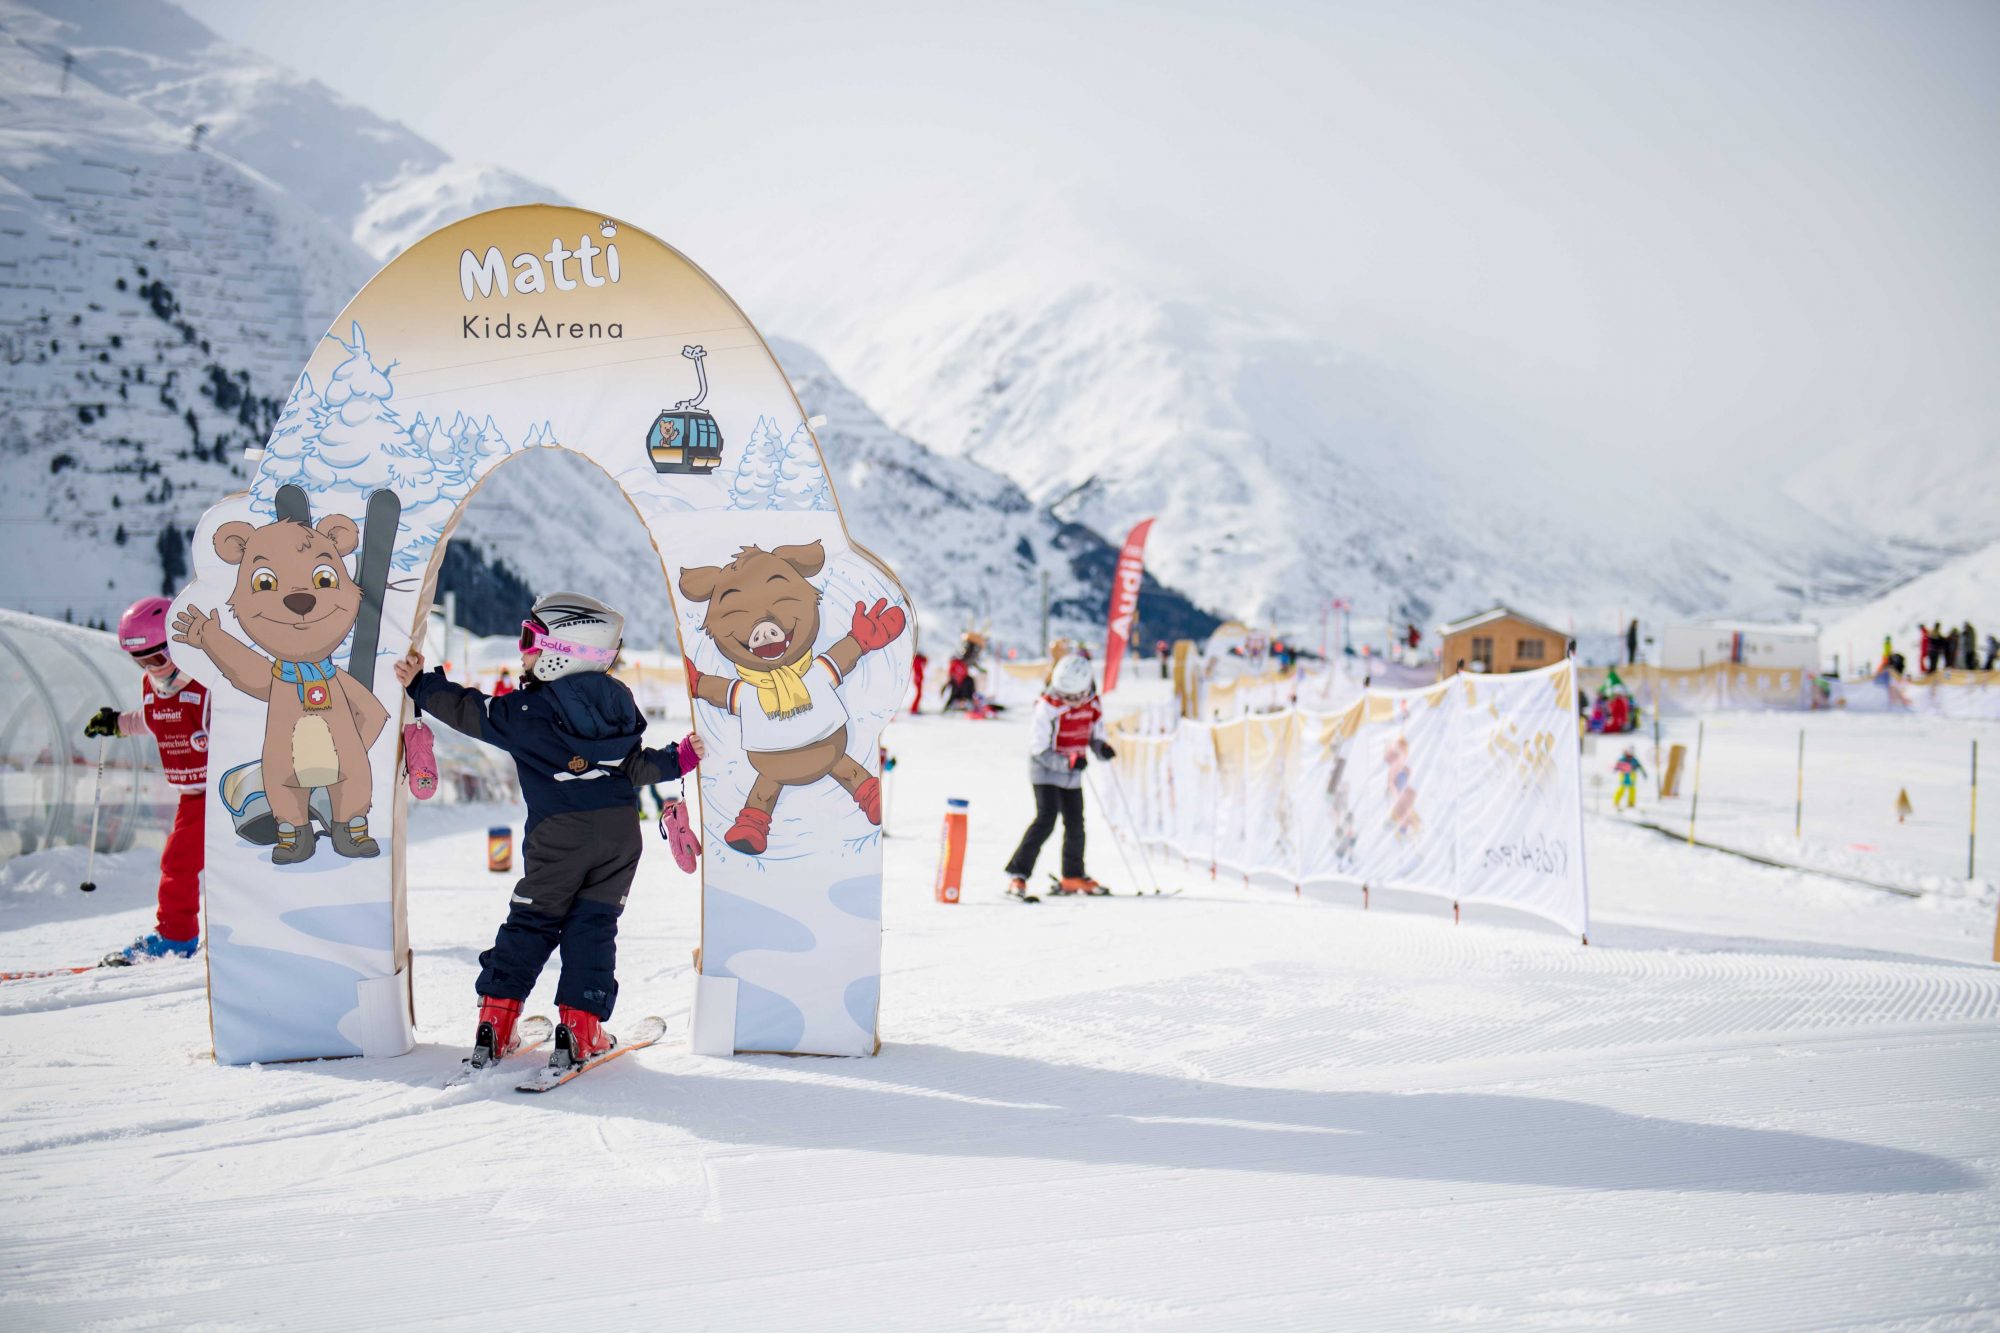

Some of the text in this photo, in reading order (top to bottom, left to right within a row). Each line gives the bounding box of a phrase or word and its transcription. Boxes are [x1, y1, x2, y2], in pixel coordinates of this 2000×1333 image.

[459, 219, 621, 302] Matti
[463, 313, 623, 339] KidsArena
[1111, 557, 1143, 642] Audi
